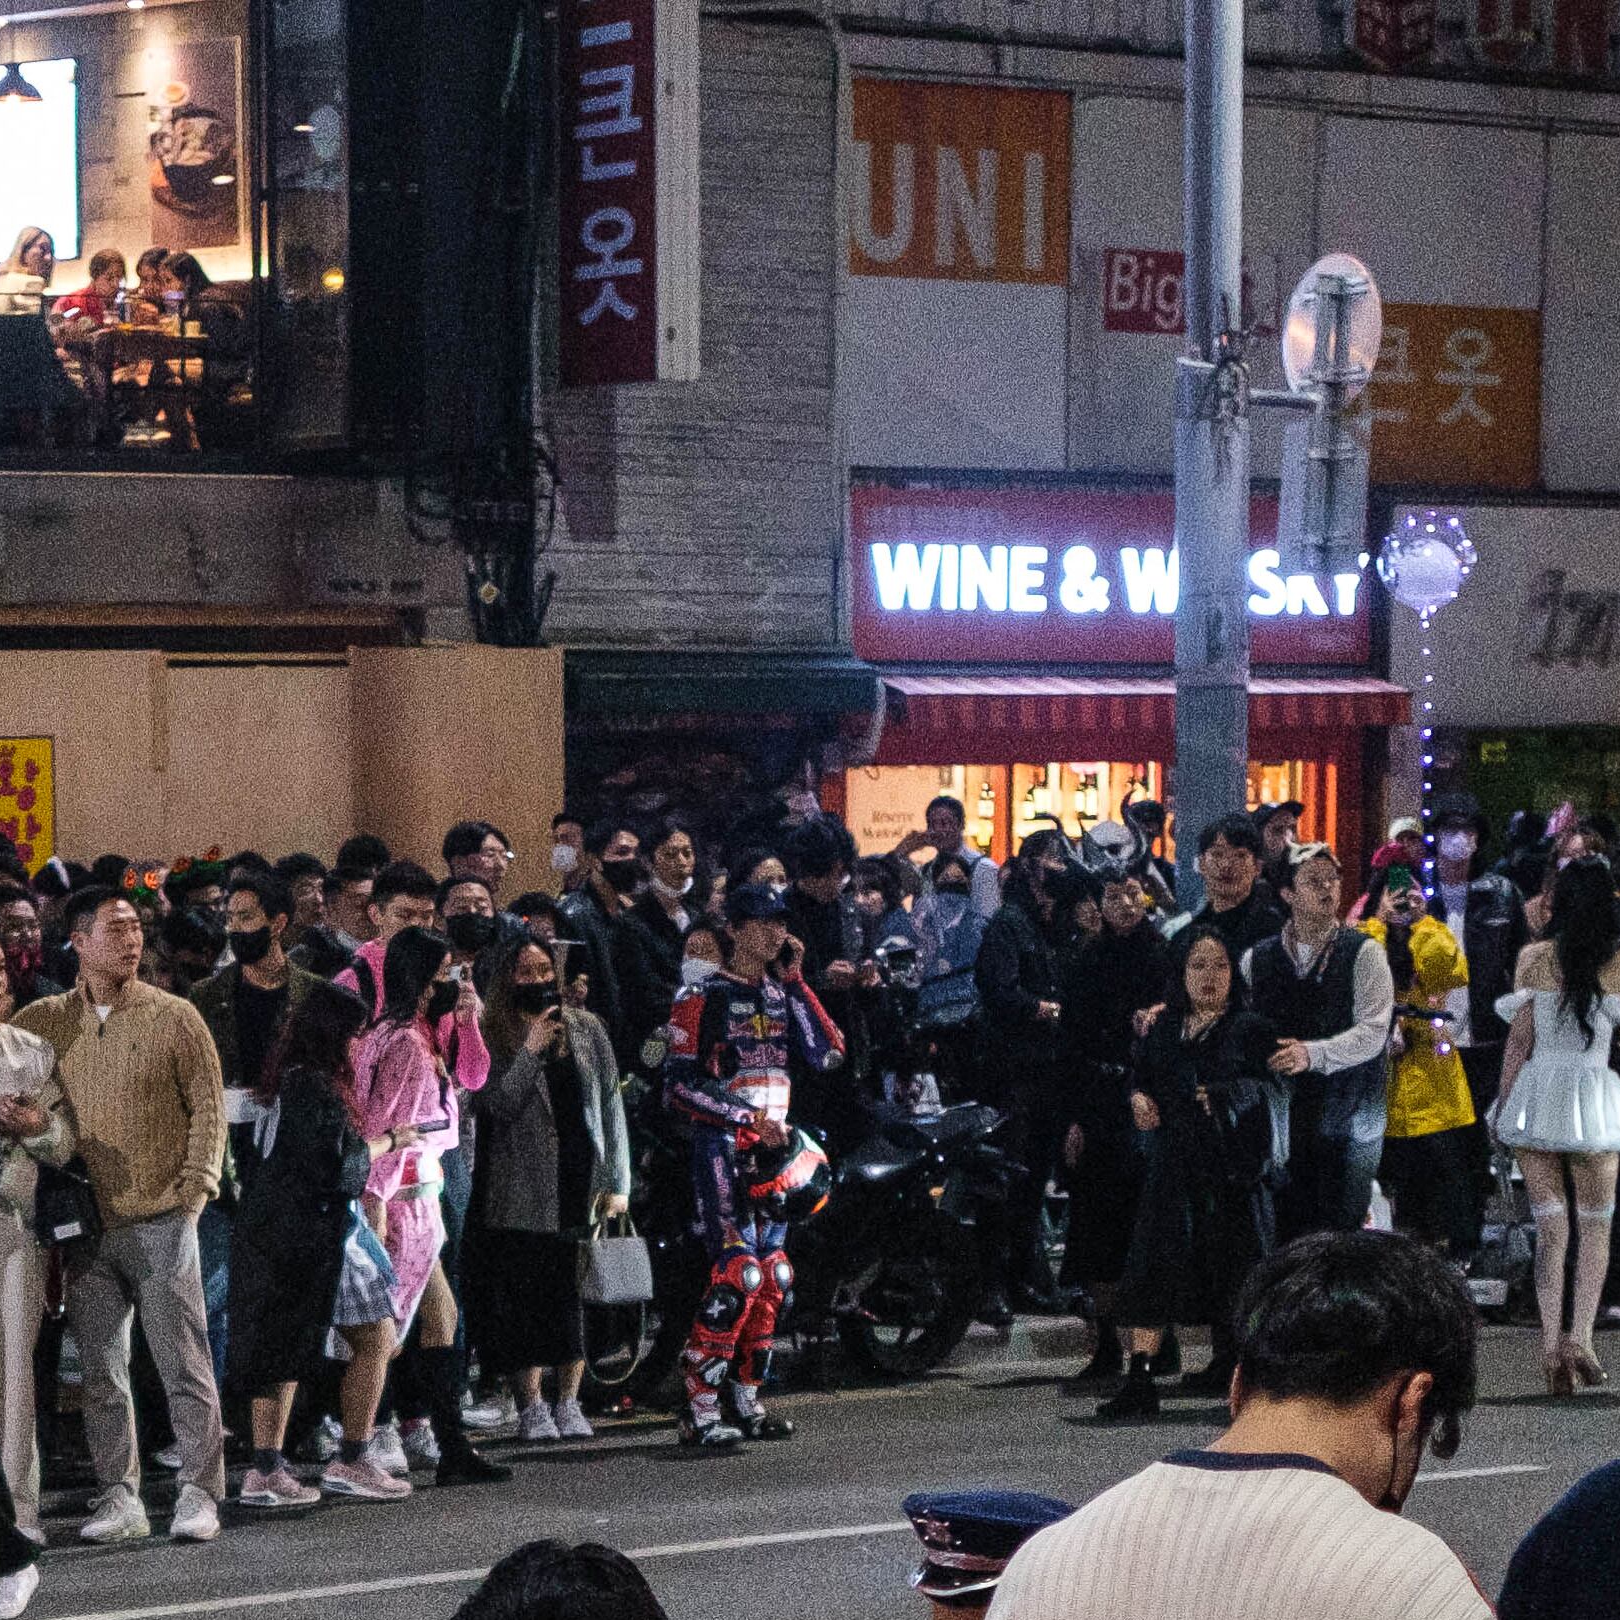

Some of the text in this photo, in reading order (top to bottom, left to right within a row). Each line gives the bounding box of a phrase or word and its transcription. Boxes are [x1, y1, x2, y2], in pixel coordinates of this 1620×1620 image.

[850, 138, 1047, 272] UNI
[871, 543, 1049, 612] WINE
[1060, 544, 1111, 614] &
